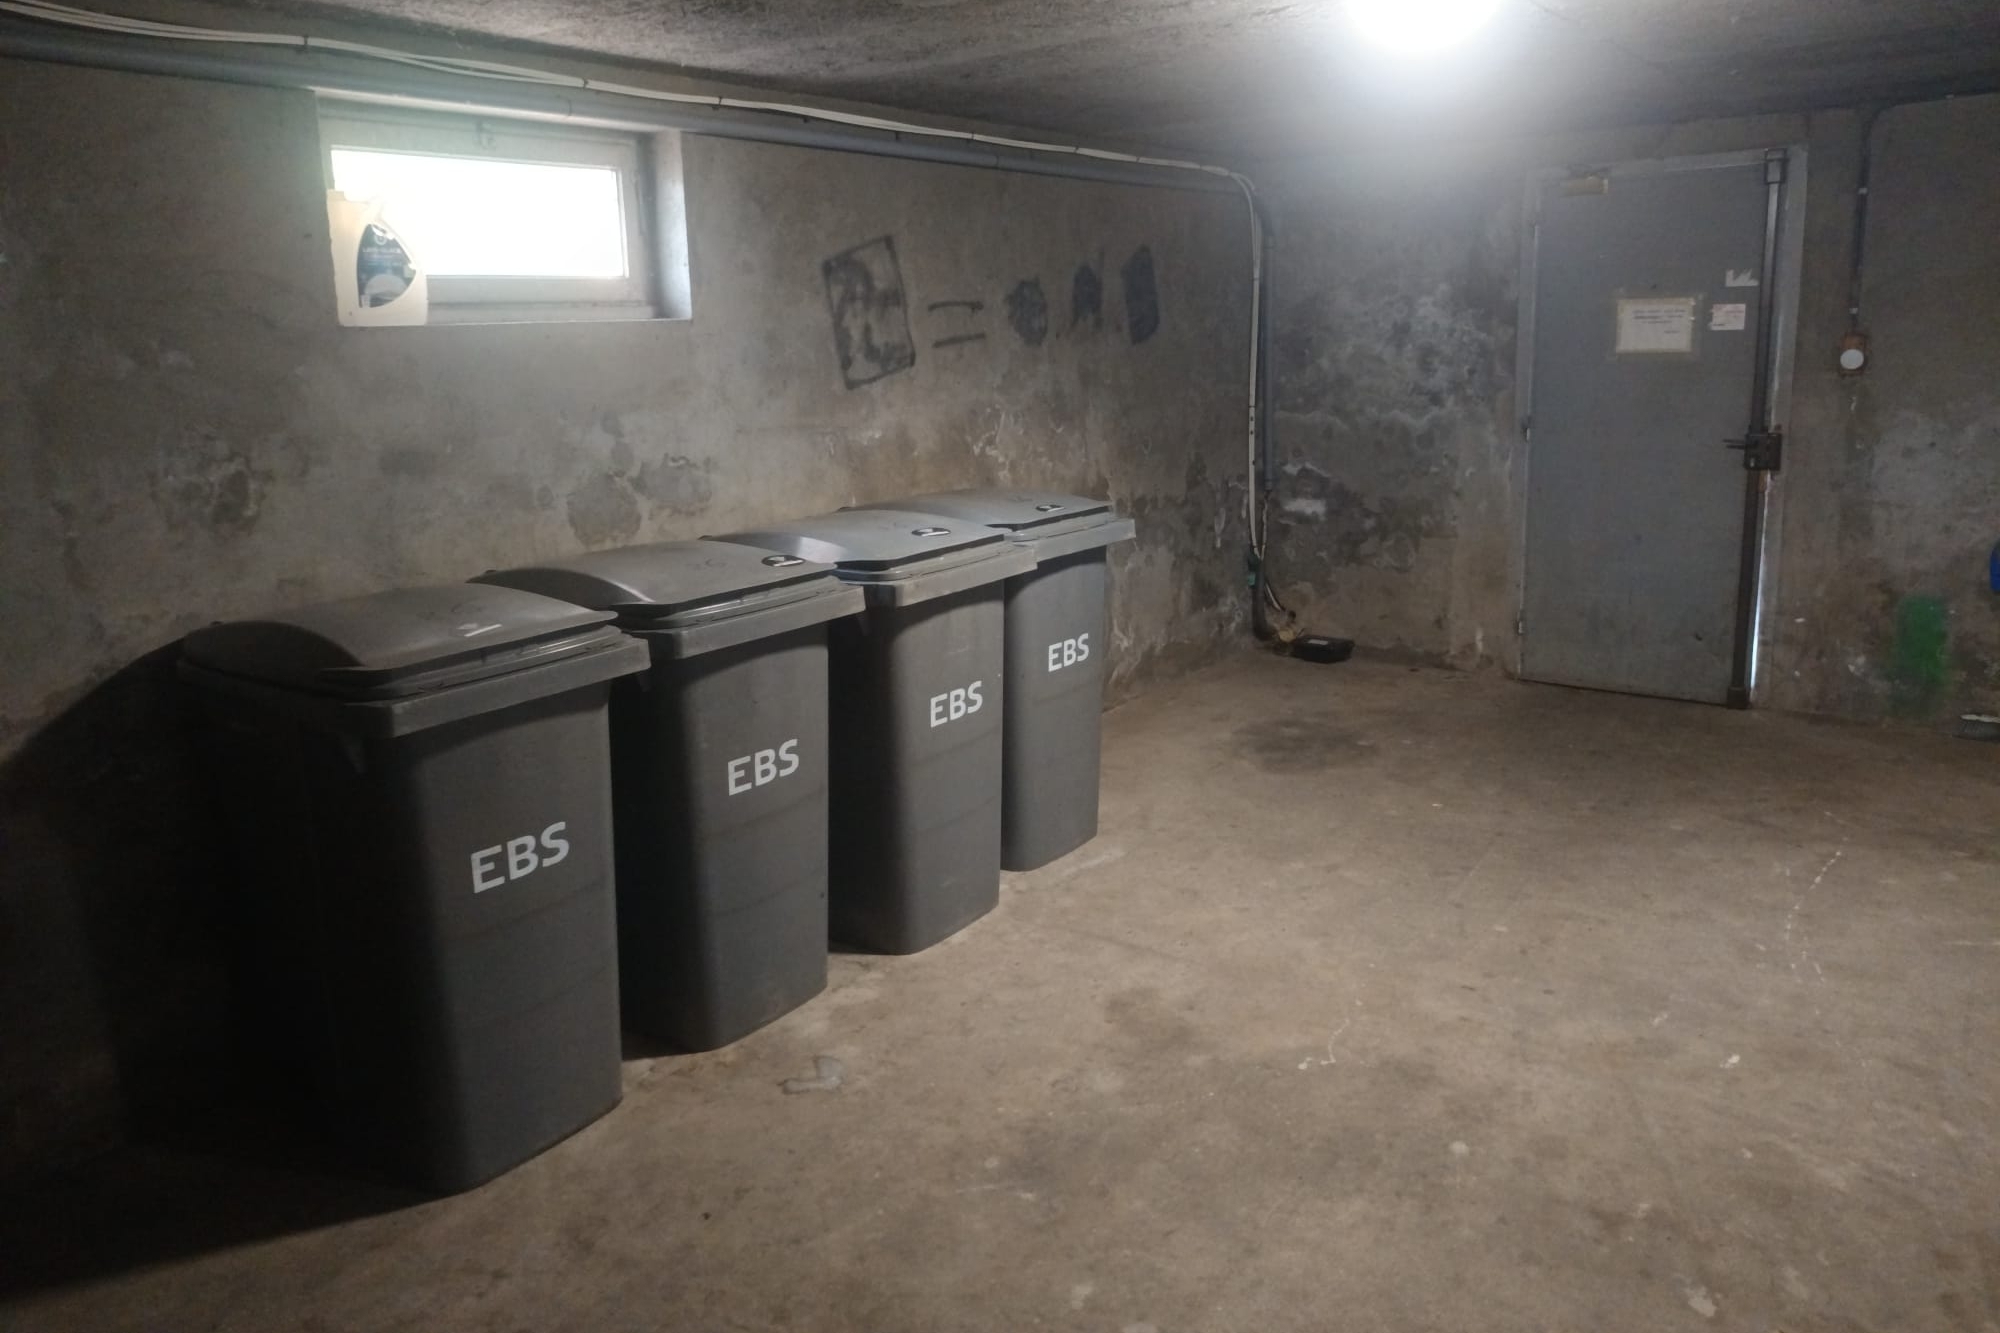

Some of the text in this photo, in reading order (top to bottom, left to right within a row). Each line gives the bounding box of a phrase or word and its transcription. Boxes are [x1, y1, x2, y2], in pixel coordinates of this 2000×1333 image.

[1049, 633, 1090, 672] EBS
[931, 681, 983, 728] EBS
[728, 738, 799, 796] EBS
[471, 821, 570, 894] EBS
